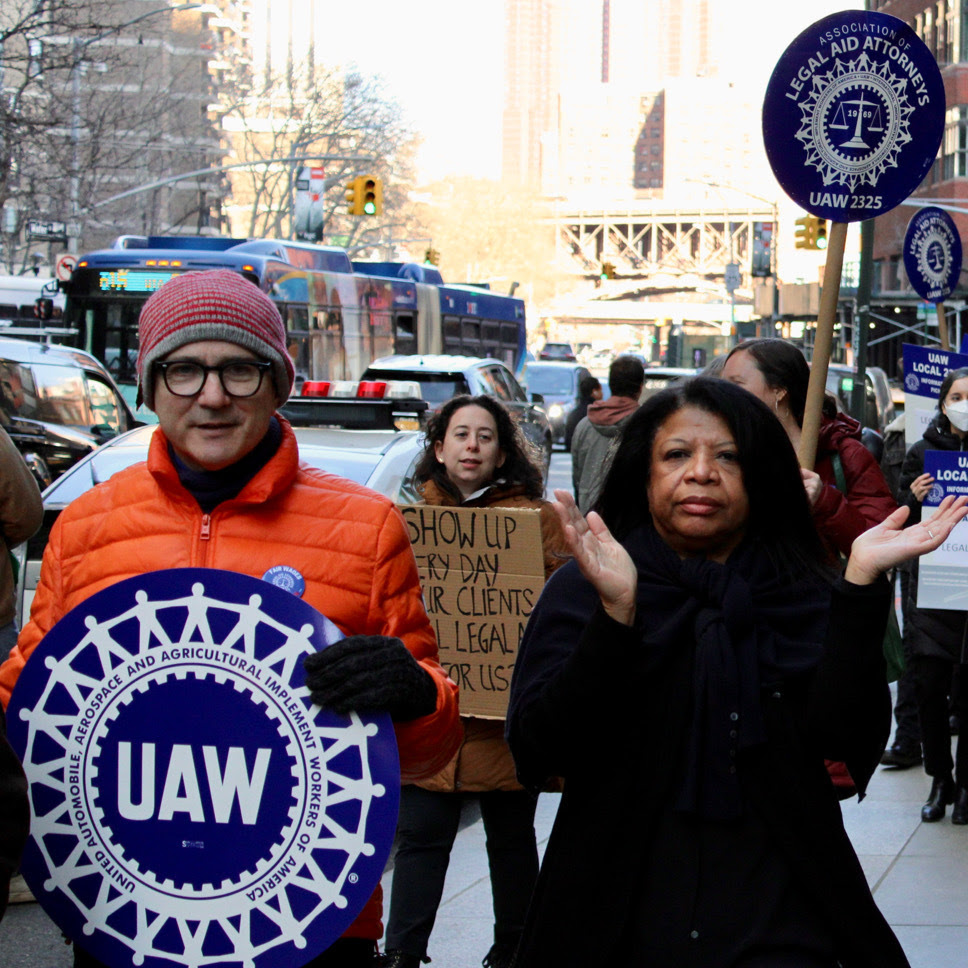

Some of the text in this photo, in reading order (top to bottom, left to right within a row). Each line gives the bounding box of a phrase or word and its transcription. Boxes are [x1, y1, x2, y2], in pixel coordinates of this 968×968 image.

[819, 23, 911, 51] ASSOCIATION OF
[785, 36, 930, 107] LEGAL AID ATTORNEYS
[809, 192, 883, 210] UAW 2325
[913, 362, 942, 377] LOCAL
[928, 353, 949, 365] UAW
[402, 508, 517, 550] SHOW UP
[460, 553, 499, 586] DAY
[457, 586, 534, 617] CLIENTS
[455, 621, 514, 655] LEGAL
[69, 647, 322, 902] UNITED AUTOMOBILE, AEROSPACE AND AGRICULTURAL IMPLEMENT WORKERS OF AMERICA
[118, 741, 272, 826] UAW
